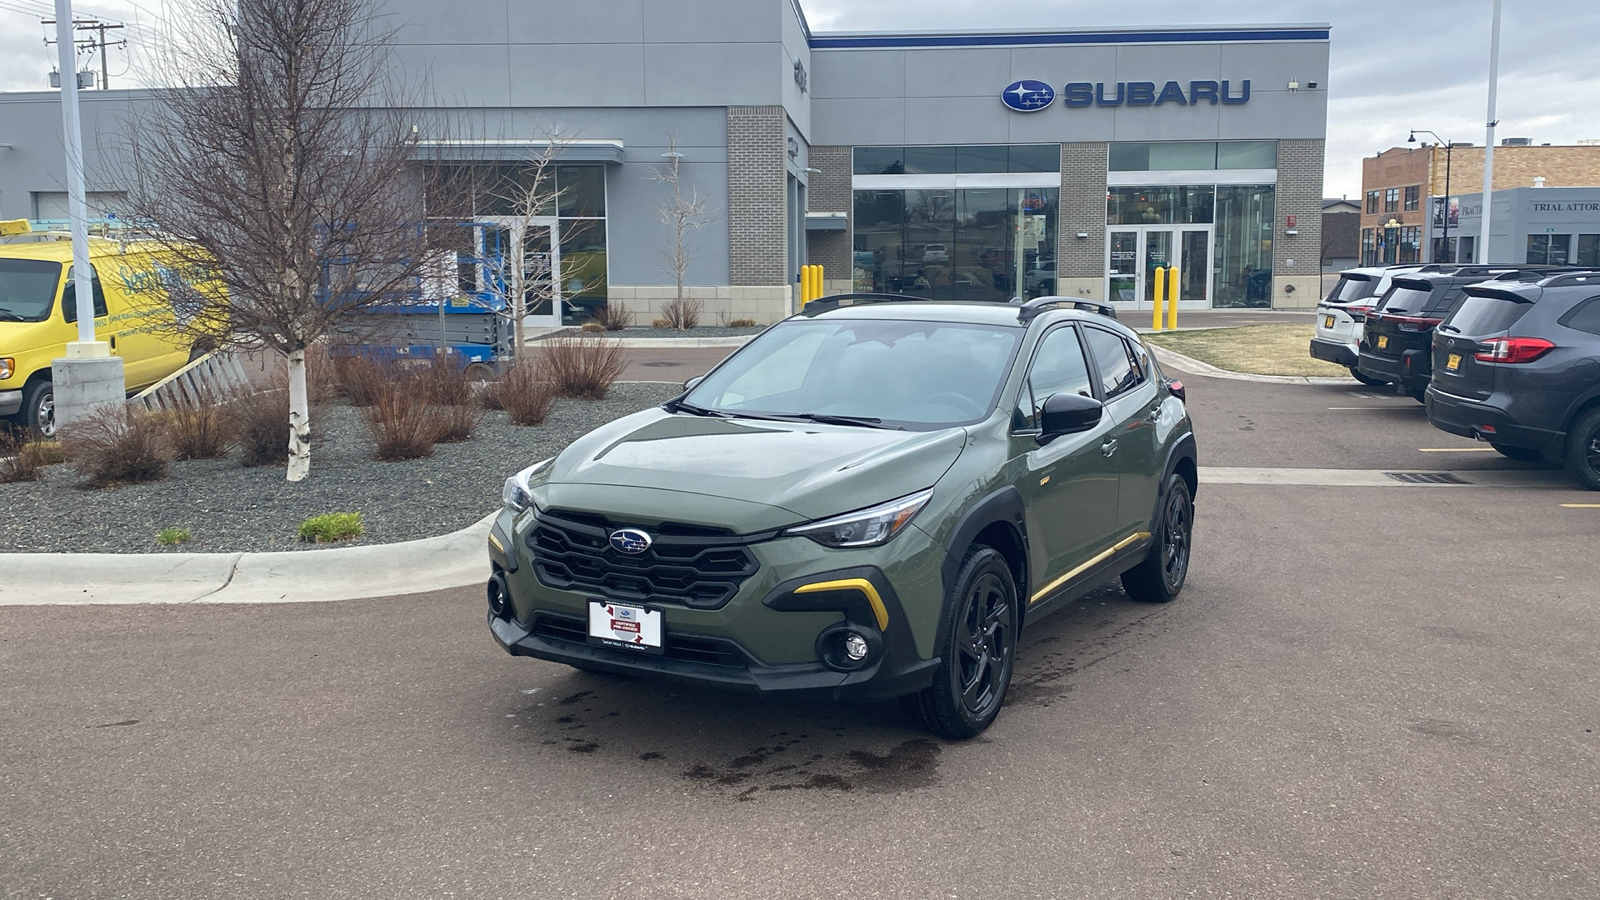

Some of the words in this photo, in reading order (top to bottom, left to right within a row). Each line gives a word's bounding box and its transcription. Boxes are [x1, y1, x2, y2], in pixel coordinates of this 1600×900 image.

[1064, 79, 1251, 107] SUBARU
[1462, 205, 1483, 216] PRACTI
[1533, 203, 1564, 211] TRIAL
[1566, 202, 1600, 211] ATTOR
